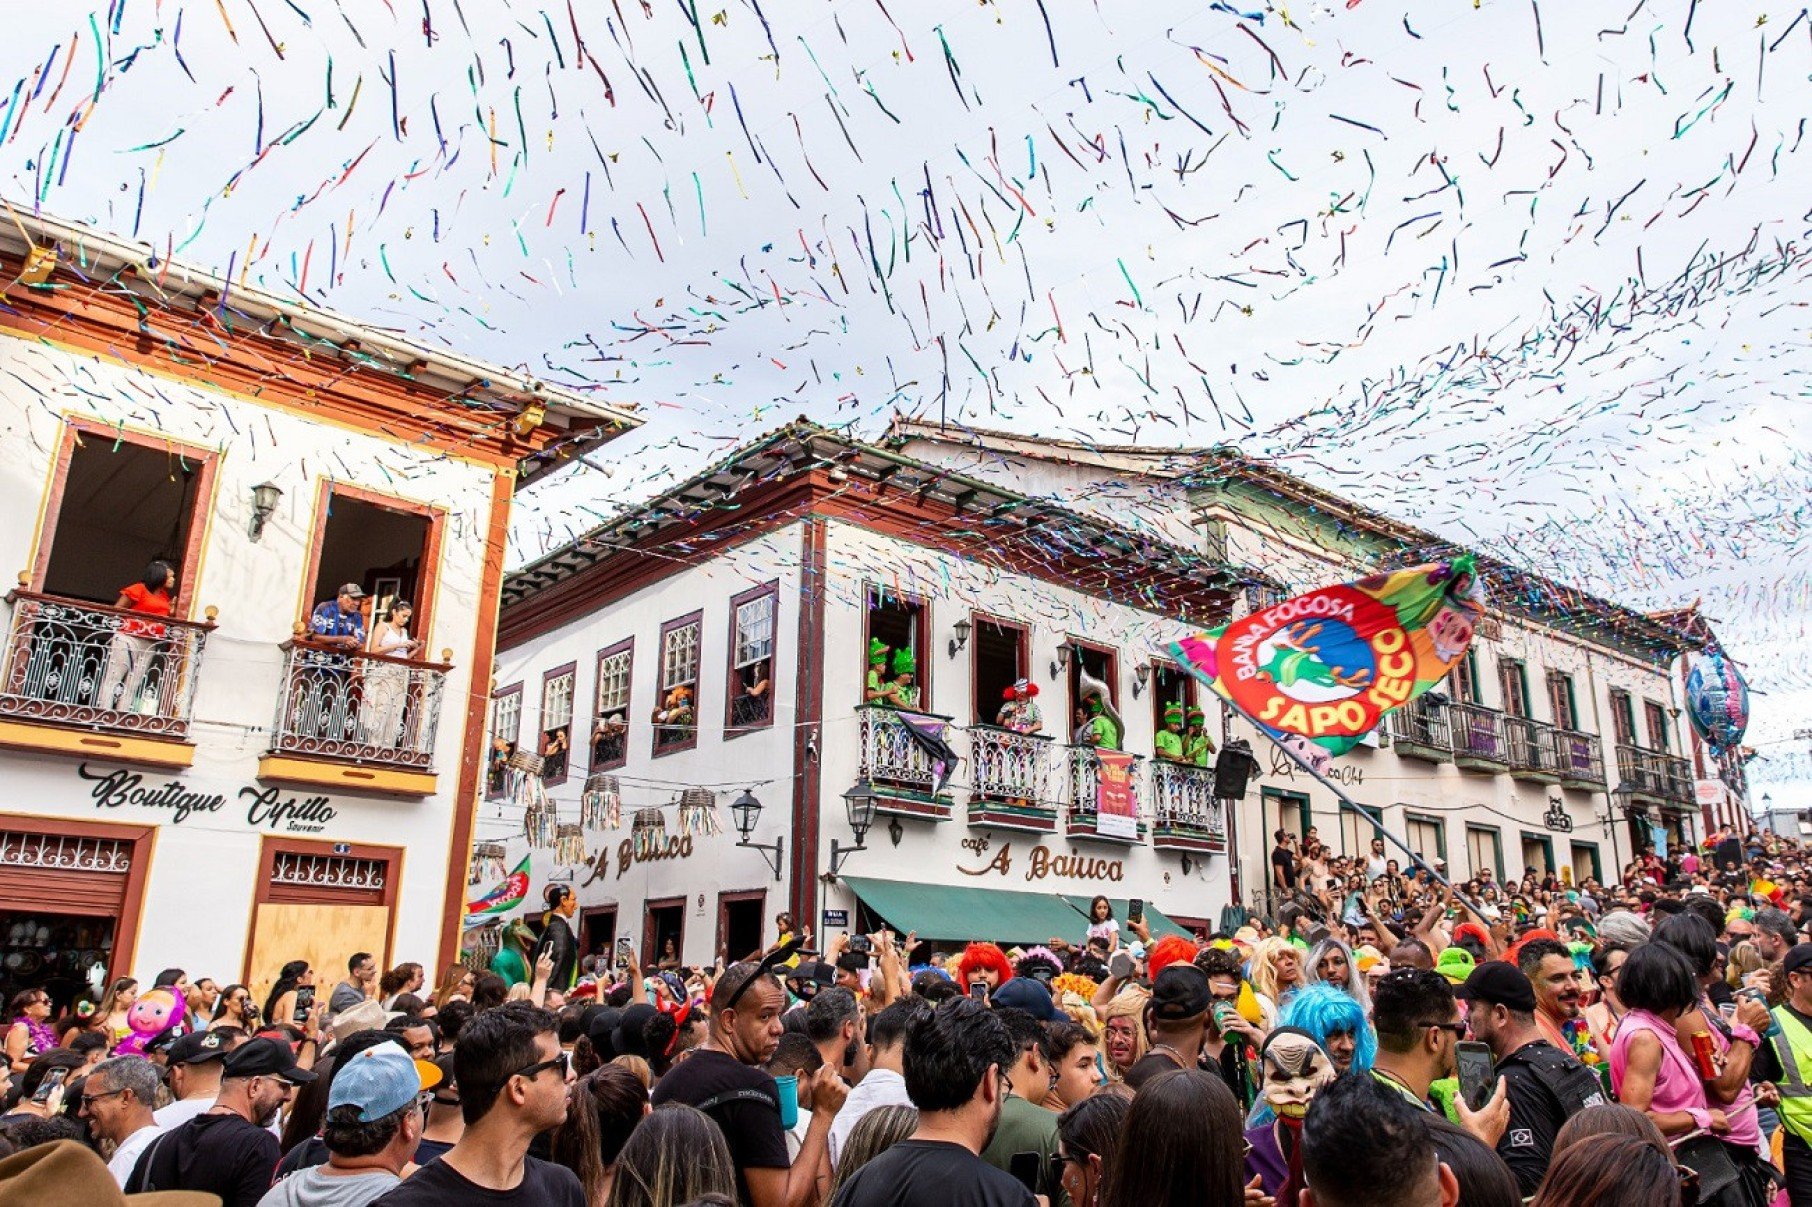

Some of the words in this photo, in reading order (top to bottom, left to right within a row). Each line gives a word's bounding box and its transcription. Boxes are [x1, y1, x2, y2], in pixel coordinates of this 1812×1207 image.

[1263, 595, 1354, 628] FOGOSA
[1259, 696, 1366, 734] SAPO
[1369, 628, 1414, 712] SECO
[78, 762, 227, 824] Boutique
[238, 786, 338, 828] Cyrillo
[286, 820, 325, 833] Souvenir
[961, 832, 992, 857] café
[581, 846, 609, 888] A
[956, 842, 1011, 876] A
[1025, 845, 1124, 881] Baiuca
